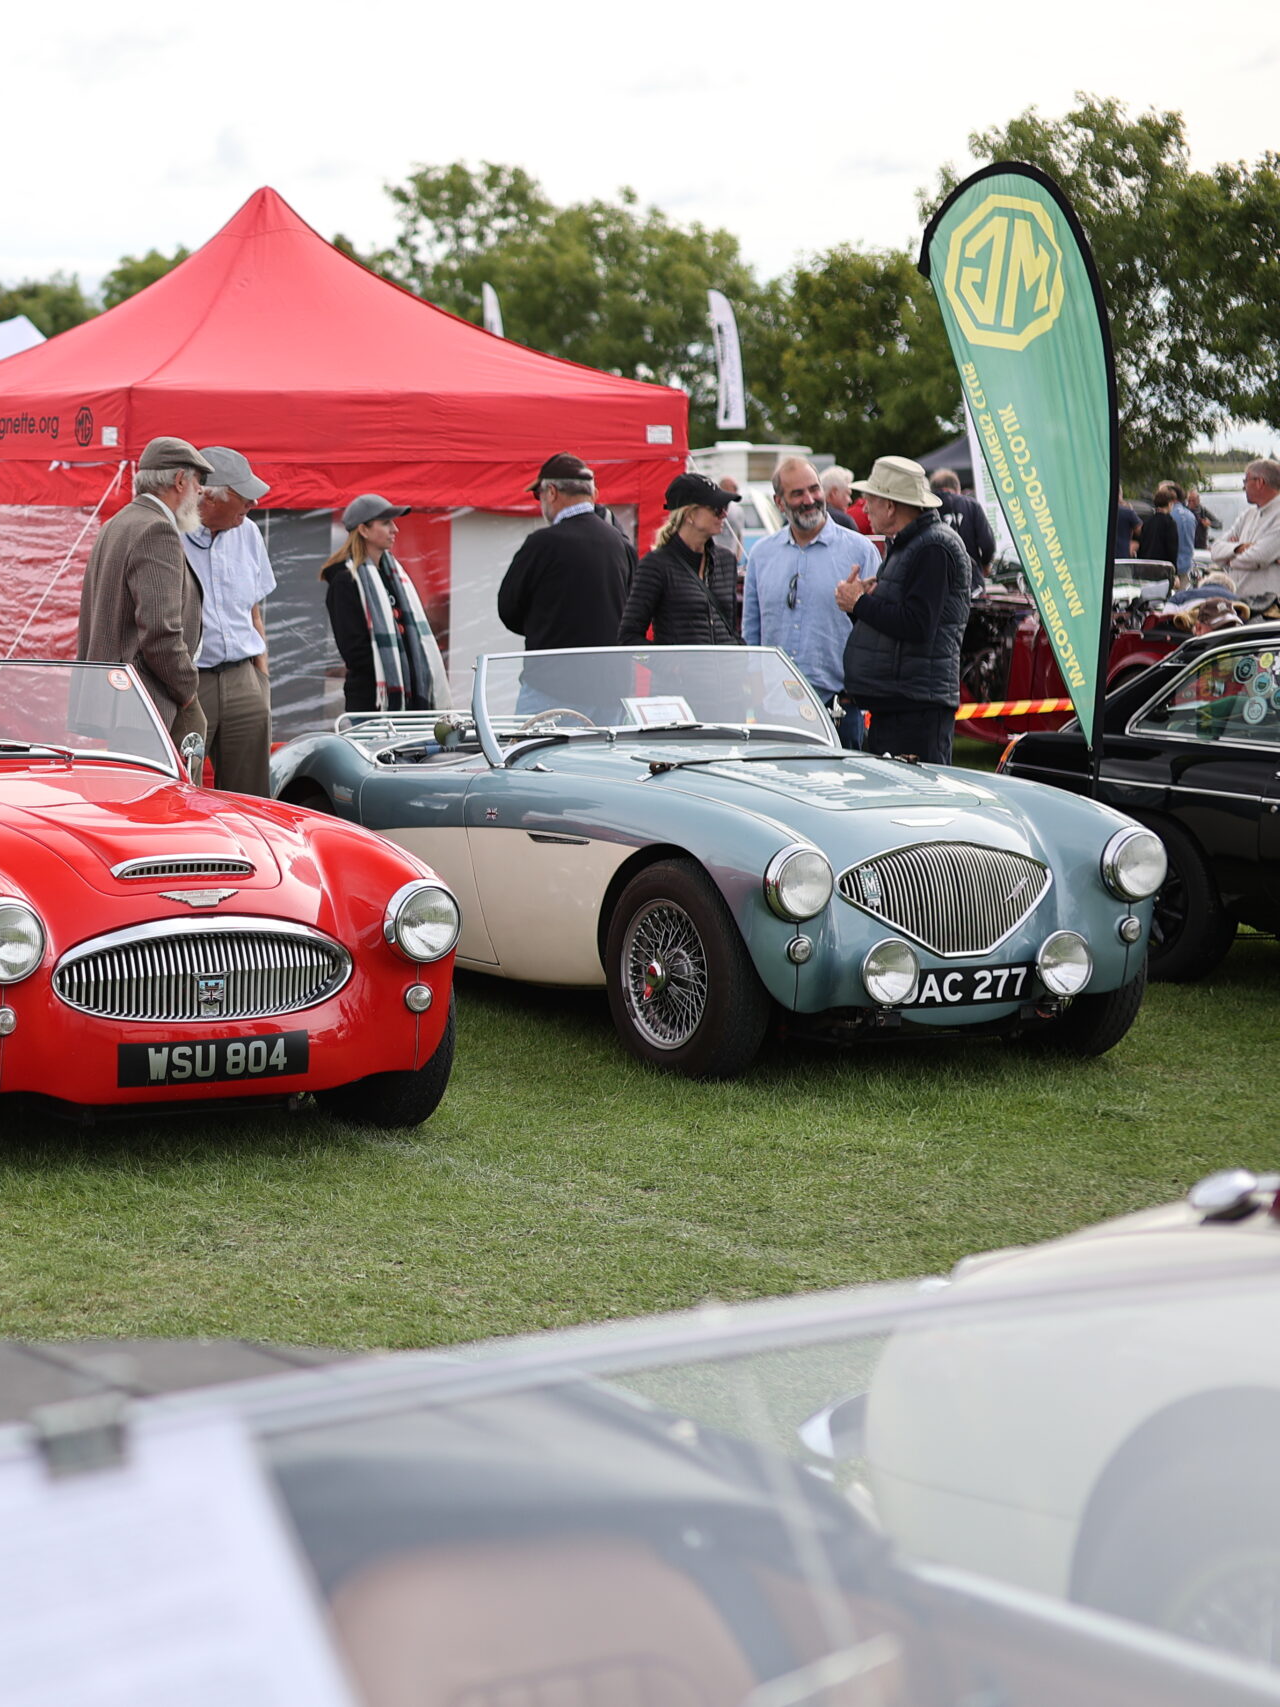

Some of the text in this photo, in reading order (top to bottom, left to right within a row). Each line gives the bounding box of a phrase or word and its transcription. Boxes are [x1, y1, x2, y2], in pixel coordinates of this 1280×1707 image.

[76, 408, 93, 445] MG
[902, 966, 1027, 1004] AC 277
[148, 1038, 288, 1081] WSU 804
